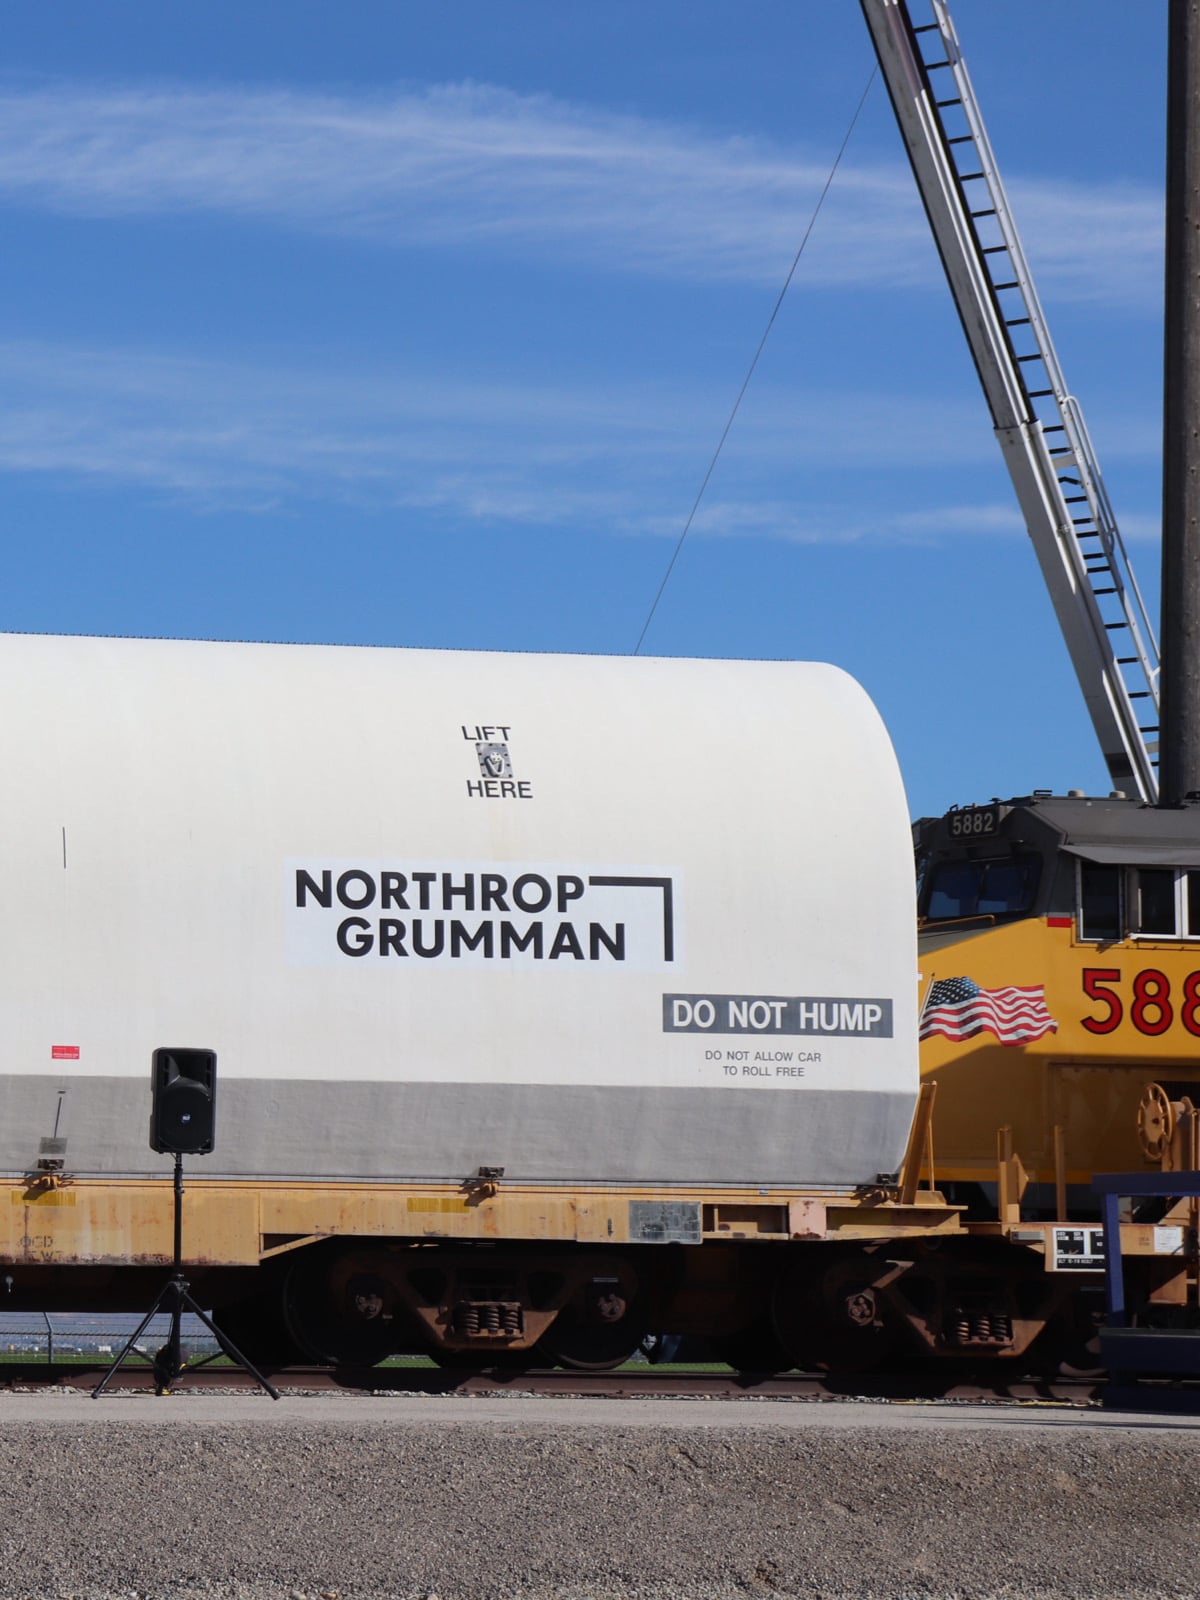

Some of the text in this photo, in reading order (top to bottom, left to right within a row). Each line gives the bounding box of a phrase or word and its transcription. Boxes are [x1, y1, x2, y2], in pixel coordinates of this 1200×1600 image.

[461, 725, 511, 741] LIFT
[466, 780, 533, 799] HERE
[952, 812, 995, 836] 5882
[295, 869, 585, 914] NORTHROP
[336, 916, 626, 961] GRUMMAN
[672, 999, 883, 1032] DO NOT HUMP
[704, 1050, 822, 1063] DO NOT ALLOW CAR
[722, 1065, 805, 1078] TO ROLL FREE
